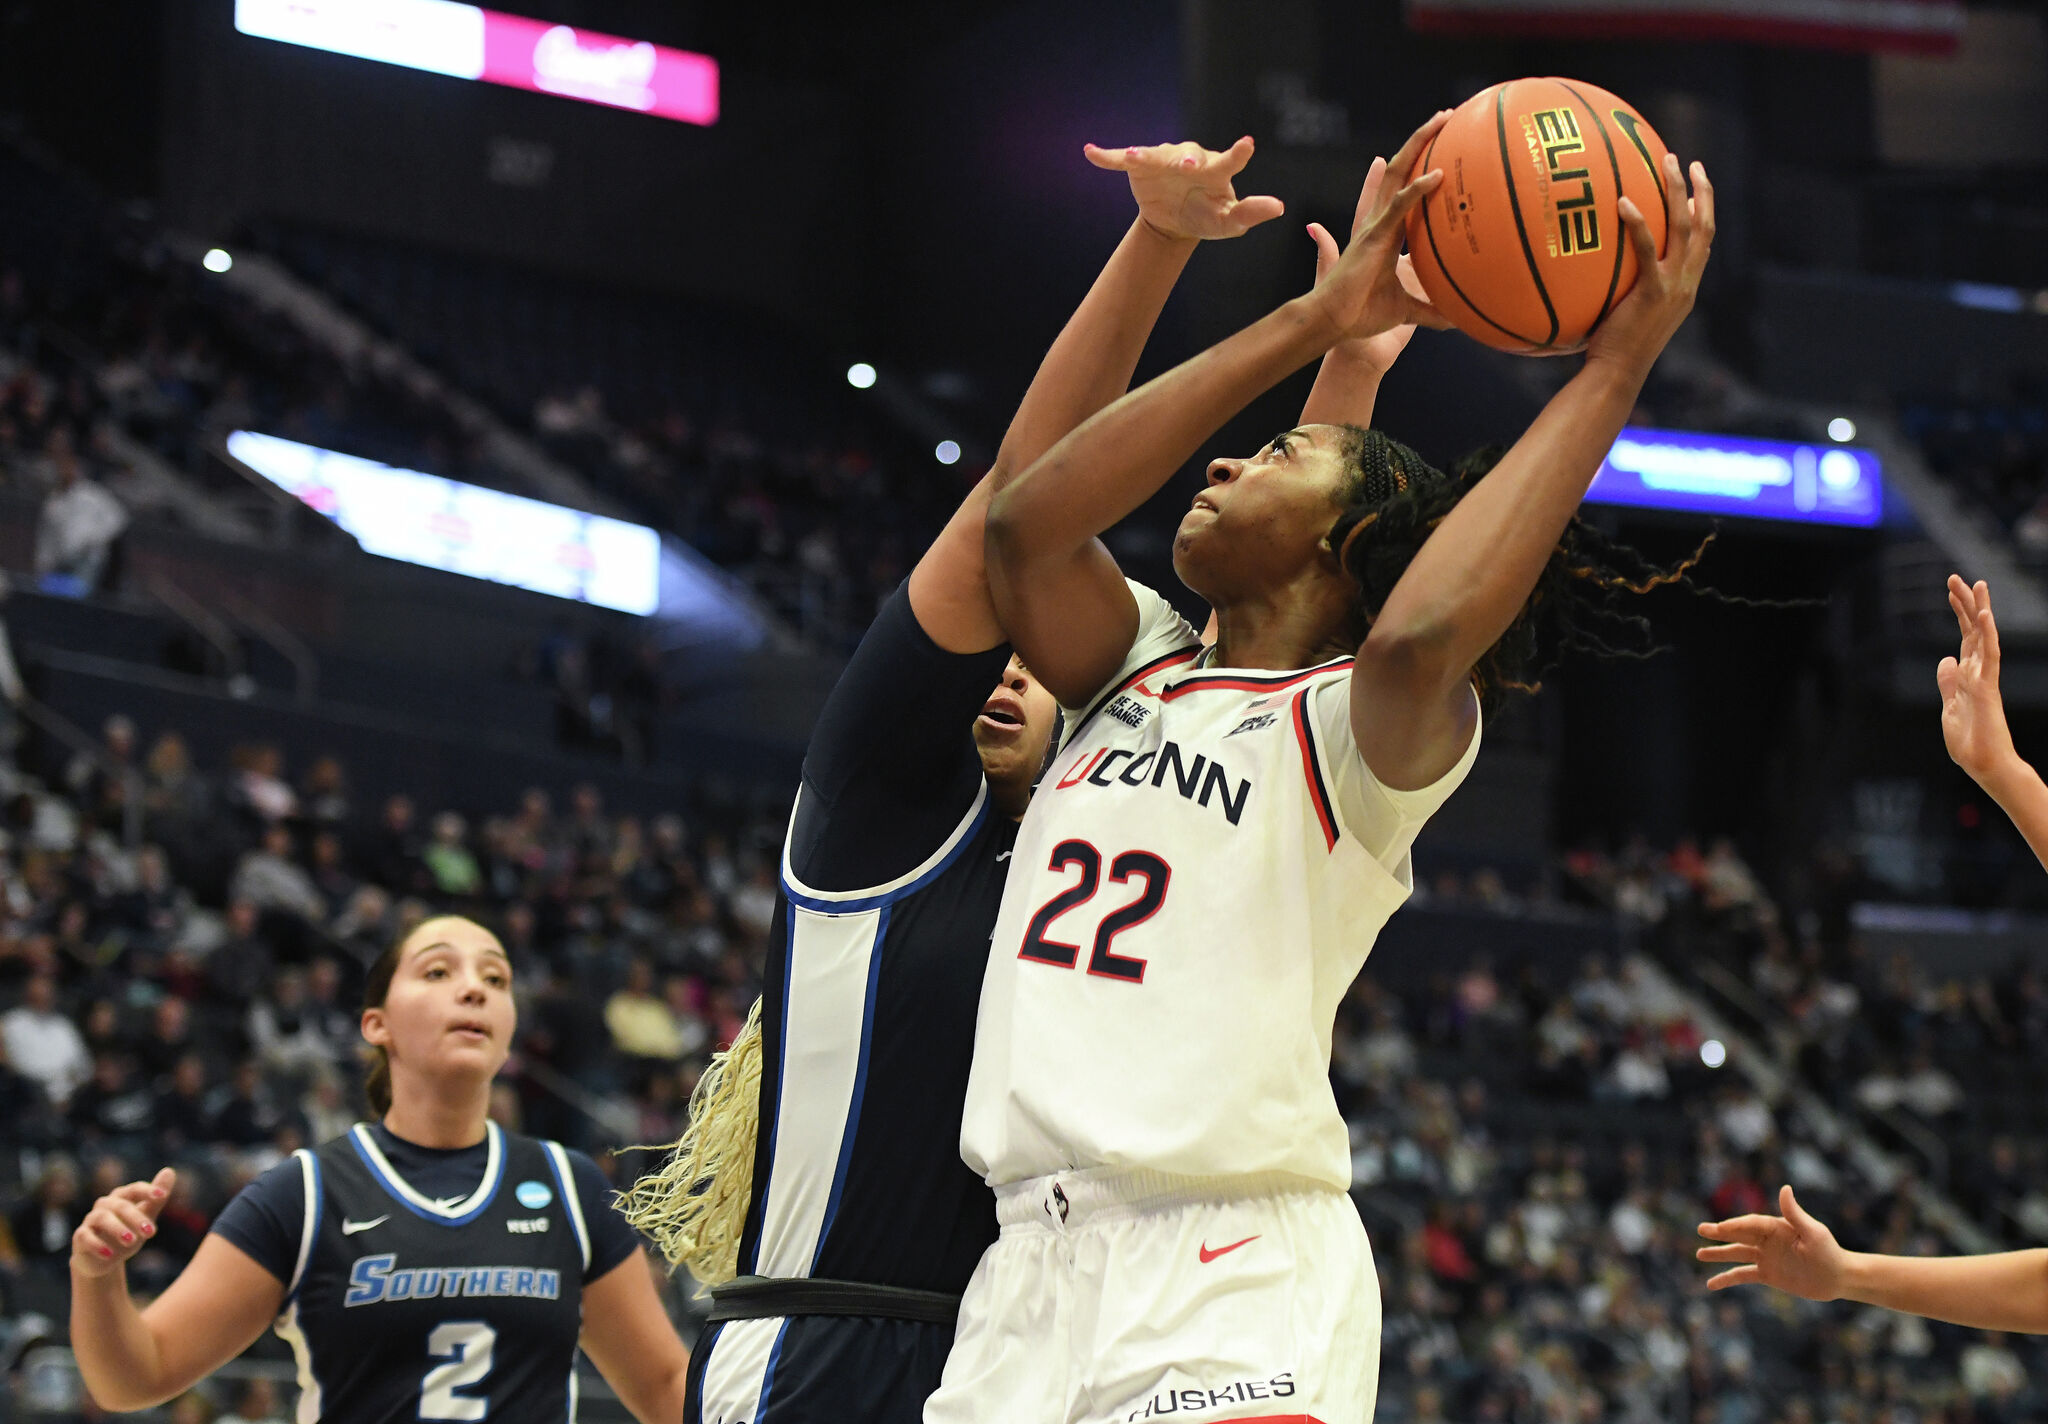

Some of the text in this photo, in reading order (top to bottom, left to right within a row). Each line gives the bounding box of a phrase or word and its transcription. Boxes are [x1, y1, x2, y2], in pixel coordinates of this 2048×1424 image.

[1519, 114, 1558, 258] CHAMPIONHIP
[1531, 107, 1602, 256] ELITE
[1104, 703, 1144, 728] CHANGE
[1114, 696, 1152, 718] BE THE
[1055, 741, 1251, 827] UCONN
[1017, 838, 1173, 985] 22
[344, 1253, 561, 1308] SOUTHERN
[418, 1321, 497, 1422] 2
[1128, 1372, 1296, 1424] HUSKIES
